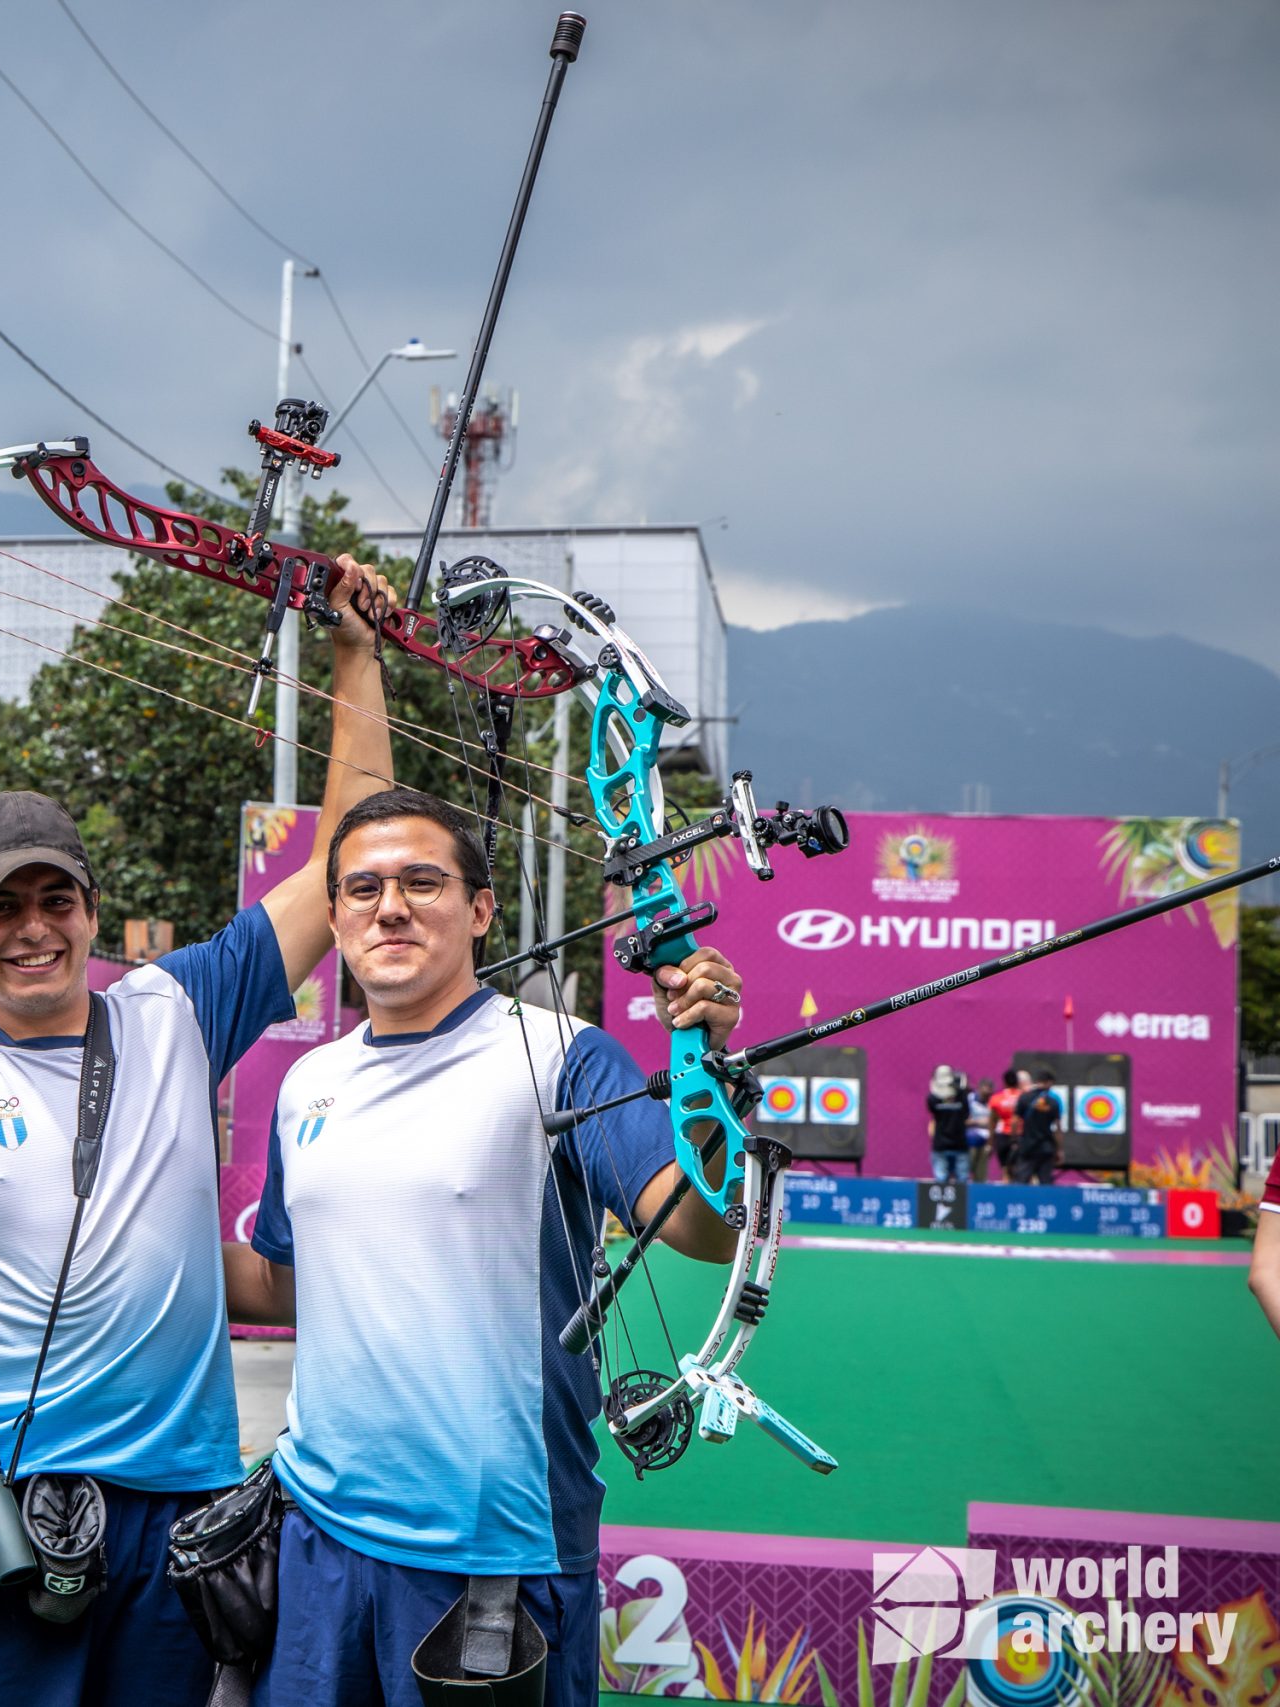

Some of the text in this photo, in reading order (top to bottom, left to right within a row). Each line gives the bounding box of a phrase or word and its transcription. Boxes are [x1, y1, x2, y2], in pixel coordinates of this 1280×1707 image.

[263, 478, 275, 509] AXCEL
[671, 825, 705, 845] AXCEL
[860, 915, 1056, 950] HYUNDAI
[890, 965, 981, 1010] RAMRODS
[814, 1019, 843, 1035] VEKTOR
[1082, 1188, 1142, 1206] Mexico
[1181, 1202, 1205, 1229] 0
[745, 1199, 760, 1273] DARTON
[768, 1208, 783, 1281] DARTON
[613, 1554, 691, 1666] 2
